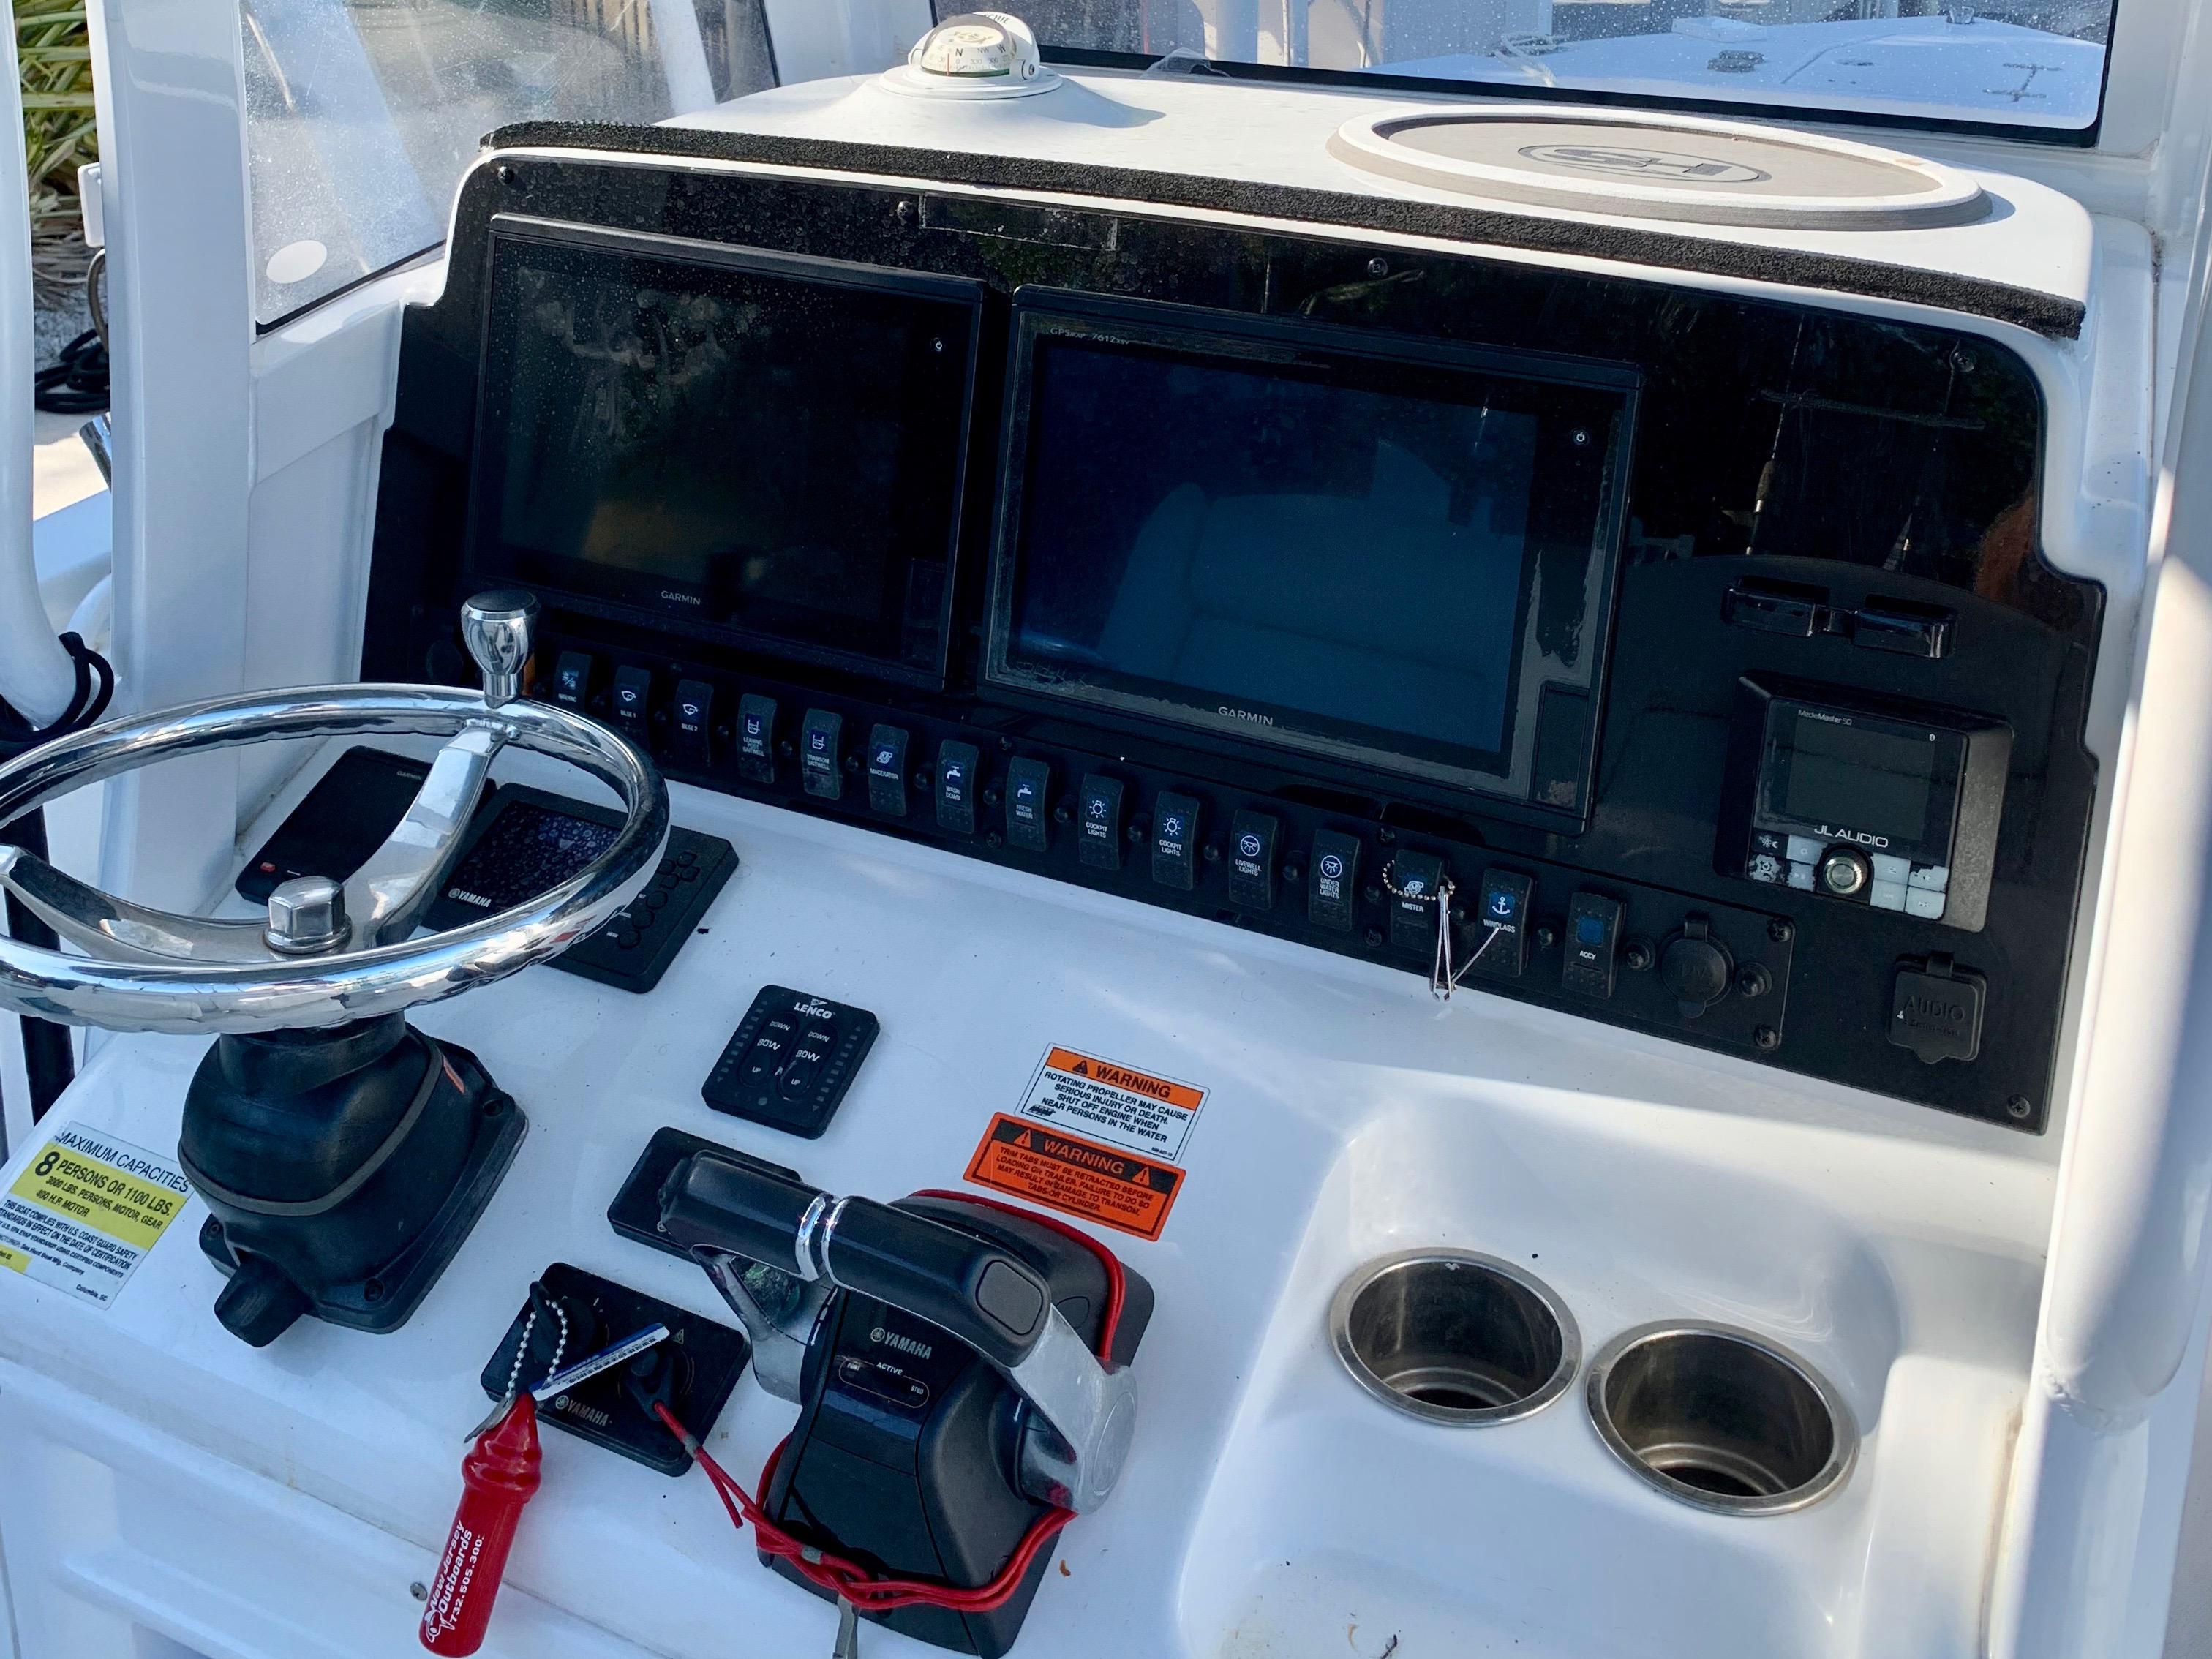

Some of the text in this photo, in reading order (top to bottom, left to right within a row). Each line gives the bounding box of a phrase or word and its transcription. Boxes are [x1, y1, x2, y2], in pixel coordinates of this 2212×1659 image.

[955, 48, 963, 56] N
[997, 44, 1006, 53] W
[661, 590, 701, 606] GARMIN
[1218, 706, 1274, 726] GARMIN
[870, 767, 899, 780] MACERATOR
[1015, 810, 1033, 819] WATER
[1016, 804, 1032, 813] FRESH
[1086, 821, 1107, 832] COCKPIT
[1087, 829, 1107, 838] LIGHTS
[1159, 839, 1182, 851] COCKPIT
[1814, 824, 1889, 849] JL AUDIO
[1161, 846, 1181, 857] LIGHTS
[1235, 859, 1262, 872] LIVEWELL
[1238, 866, 1258, 876] LIGHTS
[1320, 878, 1340, 887] UNDER
[1320, 883, 1340, 893] WATER
[457, 890, 492, 908] YAMAHA
[1319, 889, 1340, 899] LIGHTS
[1402, 901, 1424, 913] MISTER
[1483, 919, 1516, 933] WINDLASS
[1579, 949, 1596, 960] ACCY
[794, 1001, 833, 1019] LENCO
[1905, 995, 1965, 1022] AUDIO
[769, 1020, 791, 1031] DOWN
[756, 1037, 781, 1051] BOW
[808, 1030, 830, 1042] DOWN
[795, 1048, 821, 1062] BOW
[791, 1077, 800, 1086] UP
[1096, 1064, 1171, 1099] WARNING
[1044, 1070, 1189, 1121] ROTATING PROPELLER MAY CAUSE
[1054, 1083, 1168, 1124] SERIOUS INJURY OR DEATH.
[1041, 1096, 1066, 1110] NEAR
[1066, 1105, 1107, 1124] PERSONS
[1107, 1118, 1118, 1127] IN
[1118, 1121, 1137, 1133] THE
[1137, 1127, 1168, 1143] WATER
[1057, 1093, 1160, 1131] SHUT OFF ENGINE WHEN
[58, 1130, 190, 1192] MAXIMUM CAPACITIES
[1044, 1138, 1125, 1175] WARNING
[996, 1154, 1030, 1171] LOADING
[1078, 1181, 1112, 1197] FAILURE
[1113, 1192, 1124, 1201] TO
[1125, 1196, 1137, 1205] DO
[1138, 1200, 1150, 1209] SO
[1000, 1146, 1154, 1202] TRIM TABS MUST BE RETRACTED BEFORE
[34, 1151, 173, 1216] 8 PERSONS OR 1100 LBS.
[997, 1164, 1015, 1175] MAY
[1014, 1170, 1044, 1184] RESULT
[1053, 1180, 1088, 1199] DAMAGE
[1088, 1193, 1099, 1202] TO
[61, 1199, 91, 1218] MOTOR
[78, 1189, 113, 1211] PERSONS,
[113, 1203, 140, 1222] MOTOR,
[140, 1214, 163, 1230] GEAR
[1061, 1193, 1102, 1212] CYLINDER.
[4, 1199, 18, 1210] THIS
[15, 1204, 31, 1215] BOAT
[29, 1210, 57, 1227] COMPLIES
[54, 1221, 71, 1233] WITH
[78, 1230, 99, 1244] COAST
[96, 1238, 117, 1252] GUARD
[115, 1246, 138, 1261] SAFETY
[0, 1208, 132, 1271] TANDARDS IN EFFECT ON THE DATE OF CERTIFICATION
[884, 1331, 933, 1360] YAMAHA
[876, 1361, 903, 1376] ACTIVE
[910, 1385, 924, 1396] STBD
[567, 1399, 609, 1426] YAMAHA
[429, 1519, 465, 1611] New Jersey
[438, 1529, 473, 1615] Outboards
